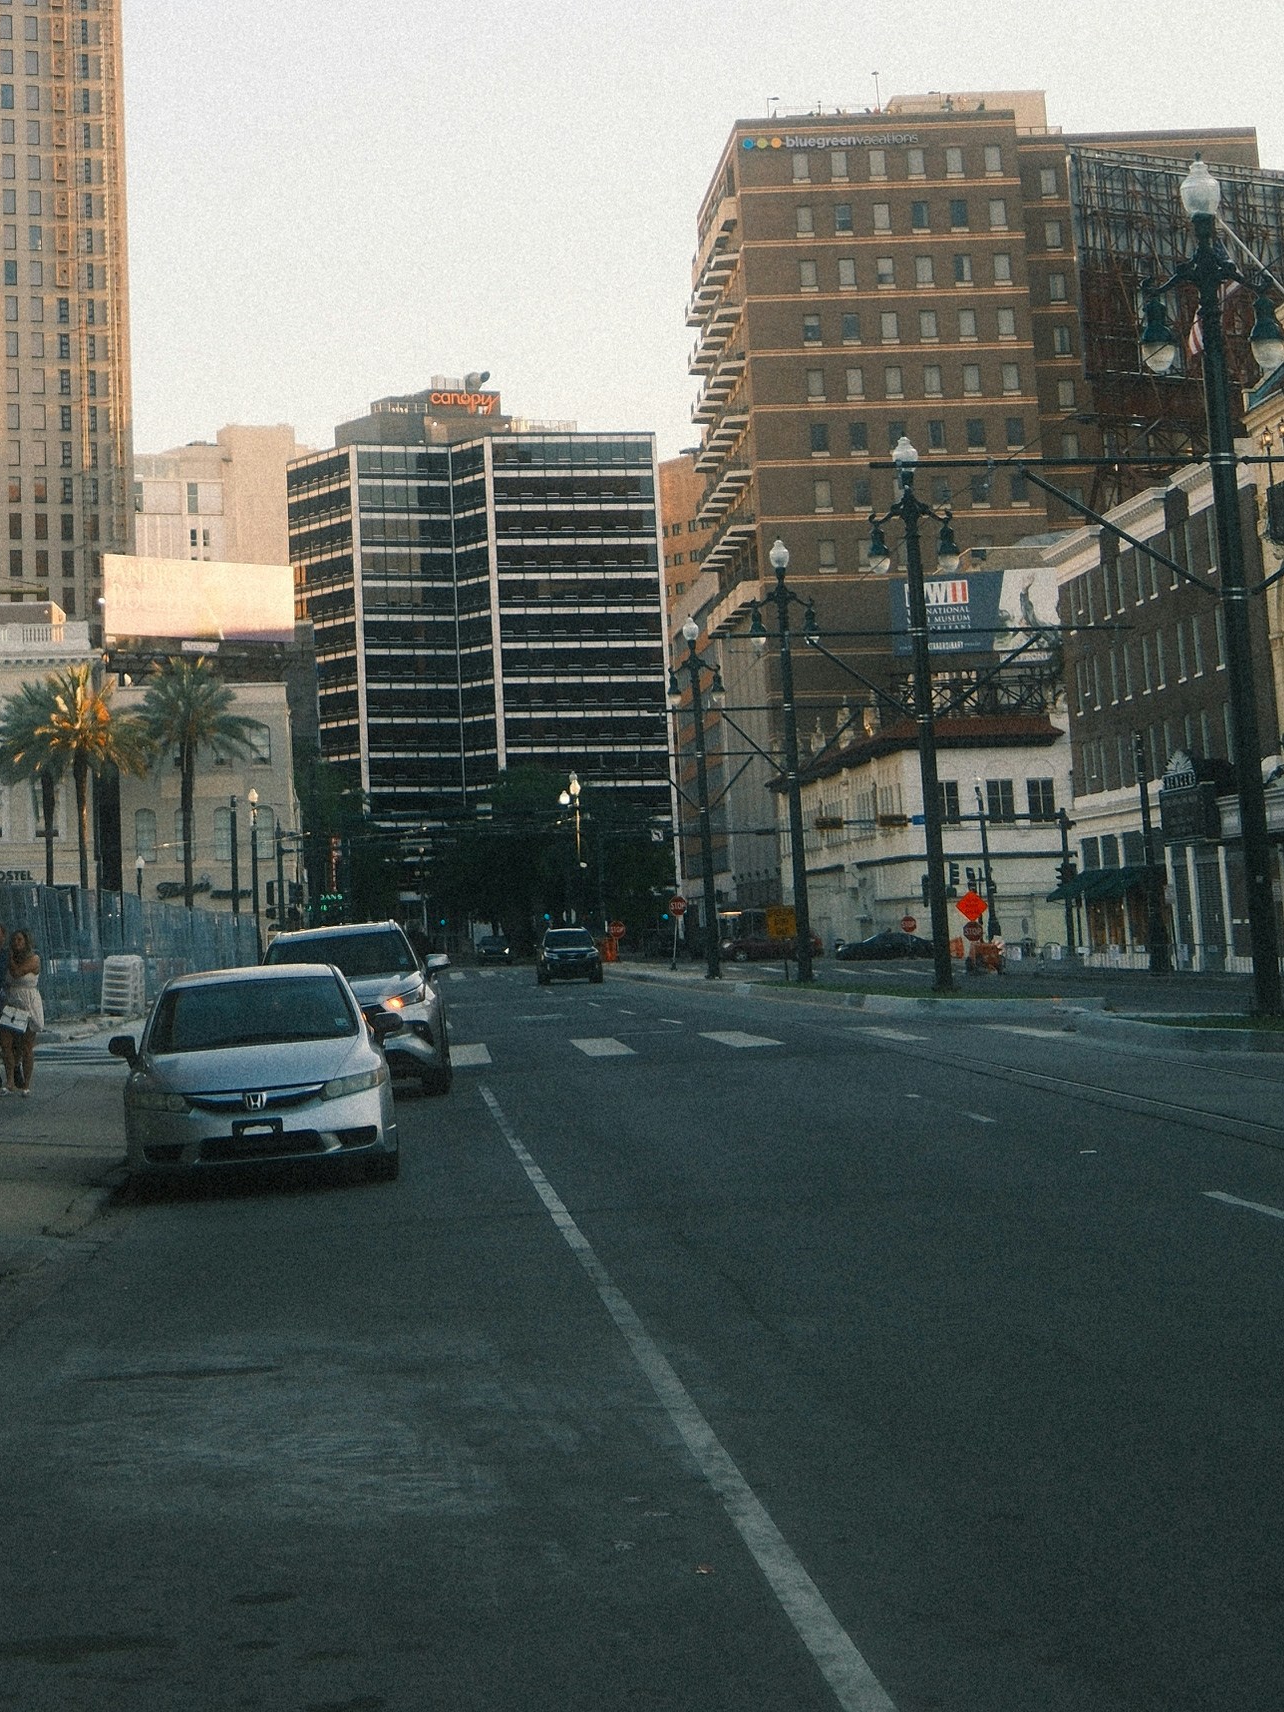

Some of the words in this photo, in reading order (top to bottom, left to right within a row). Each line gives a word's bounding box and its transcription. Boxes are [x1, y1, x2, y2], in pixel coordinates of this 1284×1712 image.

[430, 392, 501, 415] canopy
[926, 605, 971, 615] NATIONAL
[934, 614, 971, 623] MUSEUM
[670, 901, 686, 909] STOP
[965, 927, 982, 935] STOP
